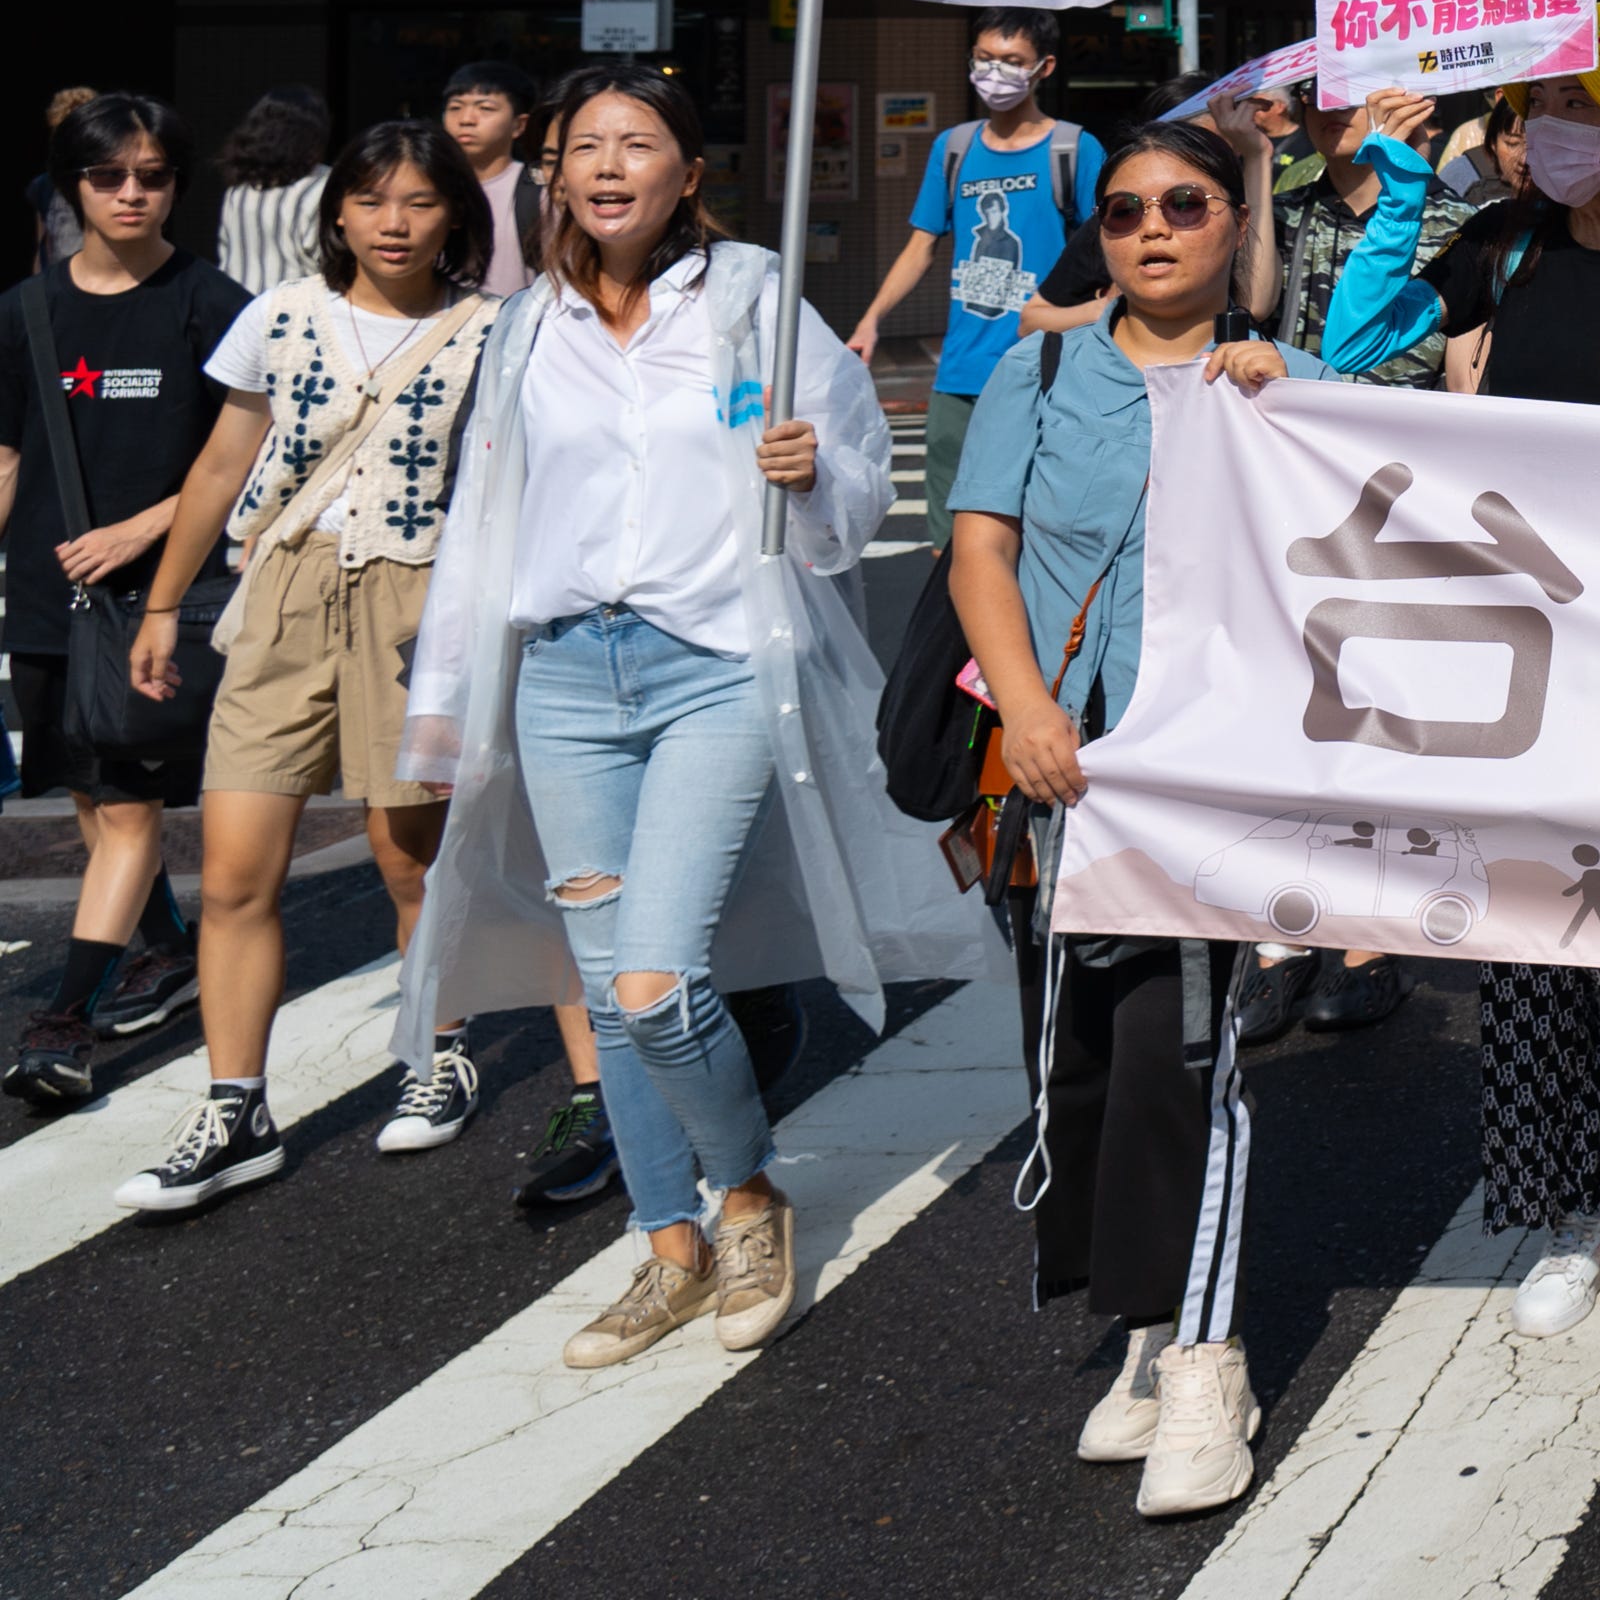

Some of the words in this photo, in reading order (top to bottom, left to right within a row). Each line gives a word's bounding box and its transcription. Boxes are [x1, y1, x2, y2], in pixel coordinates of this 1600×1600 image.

[1440, 42, 1494, 64] 時代力量
[1442, 62, 1455, 71] NEW
[1456, 60, 1476, 70] POWER
[1476, 57, 1495, 66] PARTY
[961, 174, 1036, 198] SHERLOCK
[102, 376, 163, 388] SOCIALIST
[102, 387, 160, 399] FORWARD
